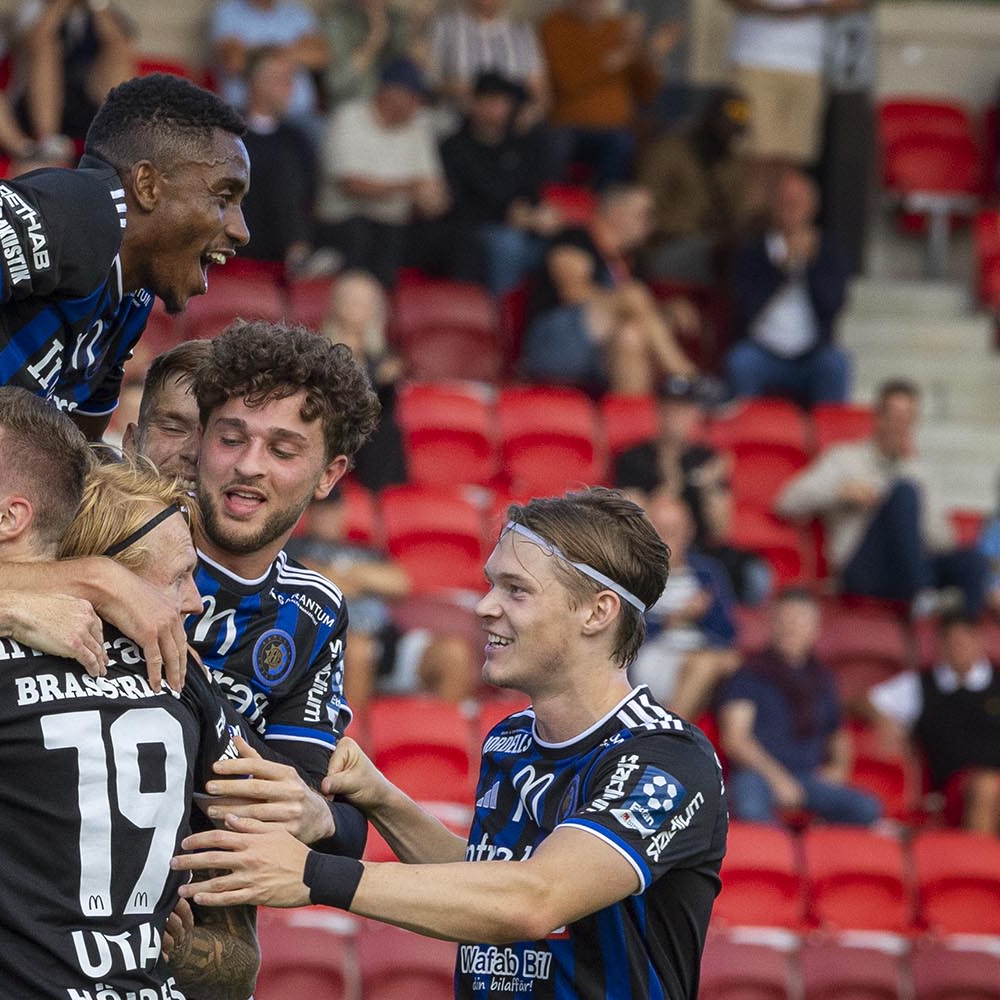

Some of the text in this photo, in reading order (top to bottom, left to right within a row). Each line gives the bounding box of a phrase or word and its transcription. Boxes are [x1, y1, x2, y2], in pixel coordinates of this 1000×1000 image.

[0, 184, 50, 270] RETHAB
[40, 708, 187, 916] 19
[461, 945, 552, 979] Wafab Bil
